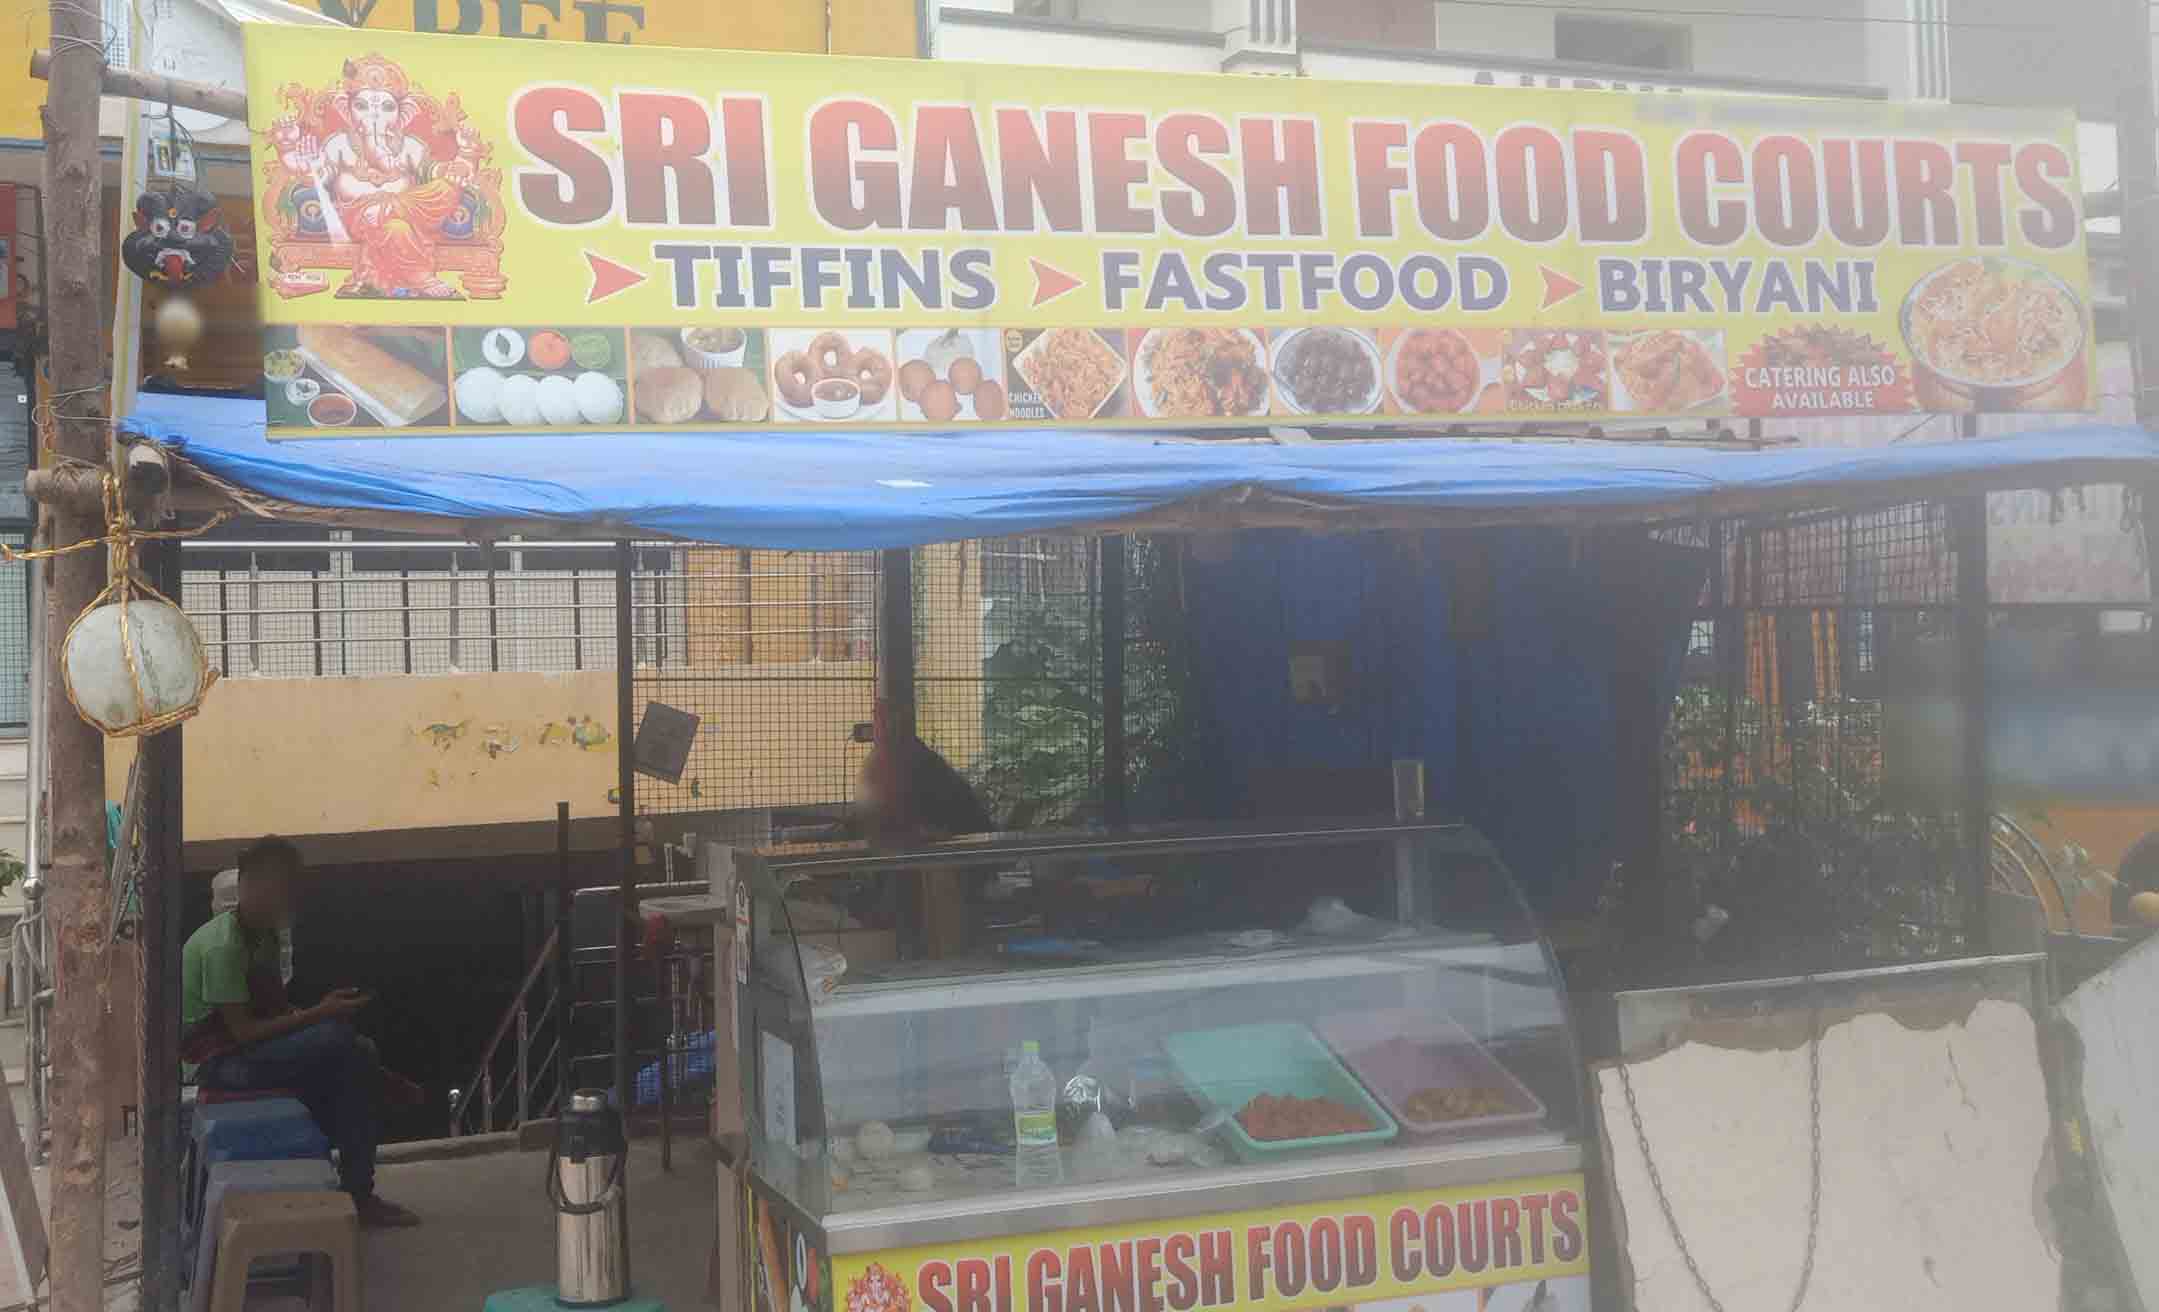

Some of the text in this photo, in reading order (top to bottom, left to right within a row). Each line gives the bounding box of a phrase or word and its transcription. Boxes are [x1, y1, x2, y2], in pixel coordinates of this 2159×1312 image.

[513, 86, 2079, 250] SRI GANESH FOOD COURTS
[654, 242, 1880, 314] TIFFINS FASTFOOD BIRYANI
[1744, 365, 1896, 388] CATERING ALSO
[1772, 391, 1874, 410] AVAILABLE
[917, 1190, 1583, 1312] SRI GANESH FOOD COURTS
